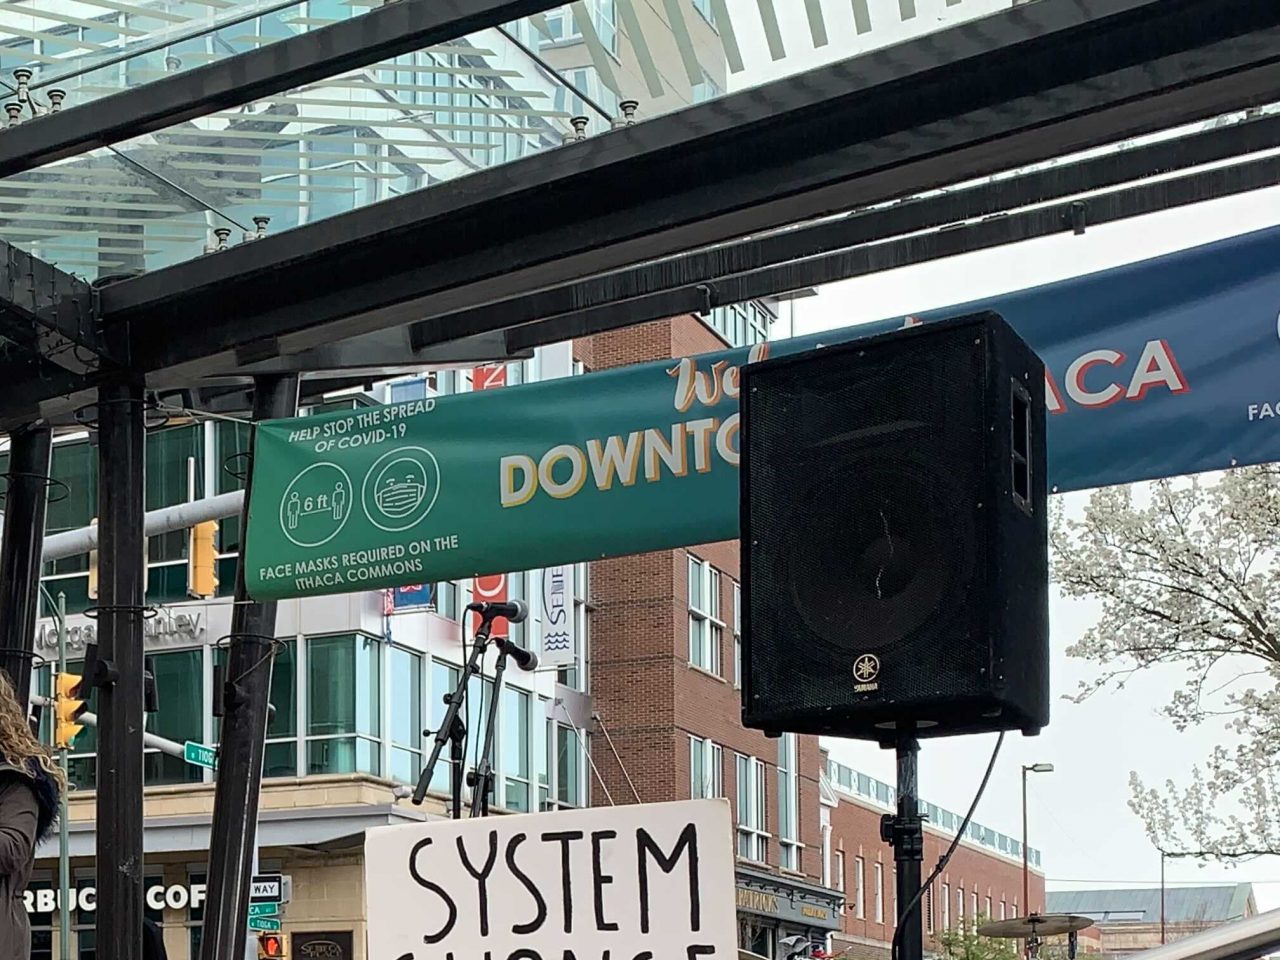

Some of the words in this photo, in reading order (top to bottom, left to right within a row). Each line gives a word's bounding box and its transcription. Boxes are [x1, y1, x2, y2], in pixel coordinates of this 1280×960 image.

[288, 427, 320, 443] HELP
[323, 418, 354, 437] STOP
[356, 411, 380, 428] THE
[383, 399, 436, 422] SPREAD
[314, 440, 336, 453] OF
[337, 423, 407, 449] COVID-19
[304, 497, 313, 512] 6
[317, 494, 329, 509] ft
[259, 562, 293, 581] FACE
[295, 556, 339, 575] MASKS
[342, 544, 405, 567] REQUIRED
[408, 540, 431, 556] ON
[434, 535, 459, 550] THE
[295, 573, 345, 591] ITHACA
[347, 558, 423, 582] COMMONS
[198, 749, 215, 766] TIOG
[254, 884, 275, 894] WAY
[409, 823, 702, 944] SYSTEM
